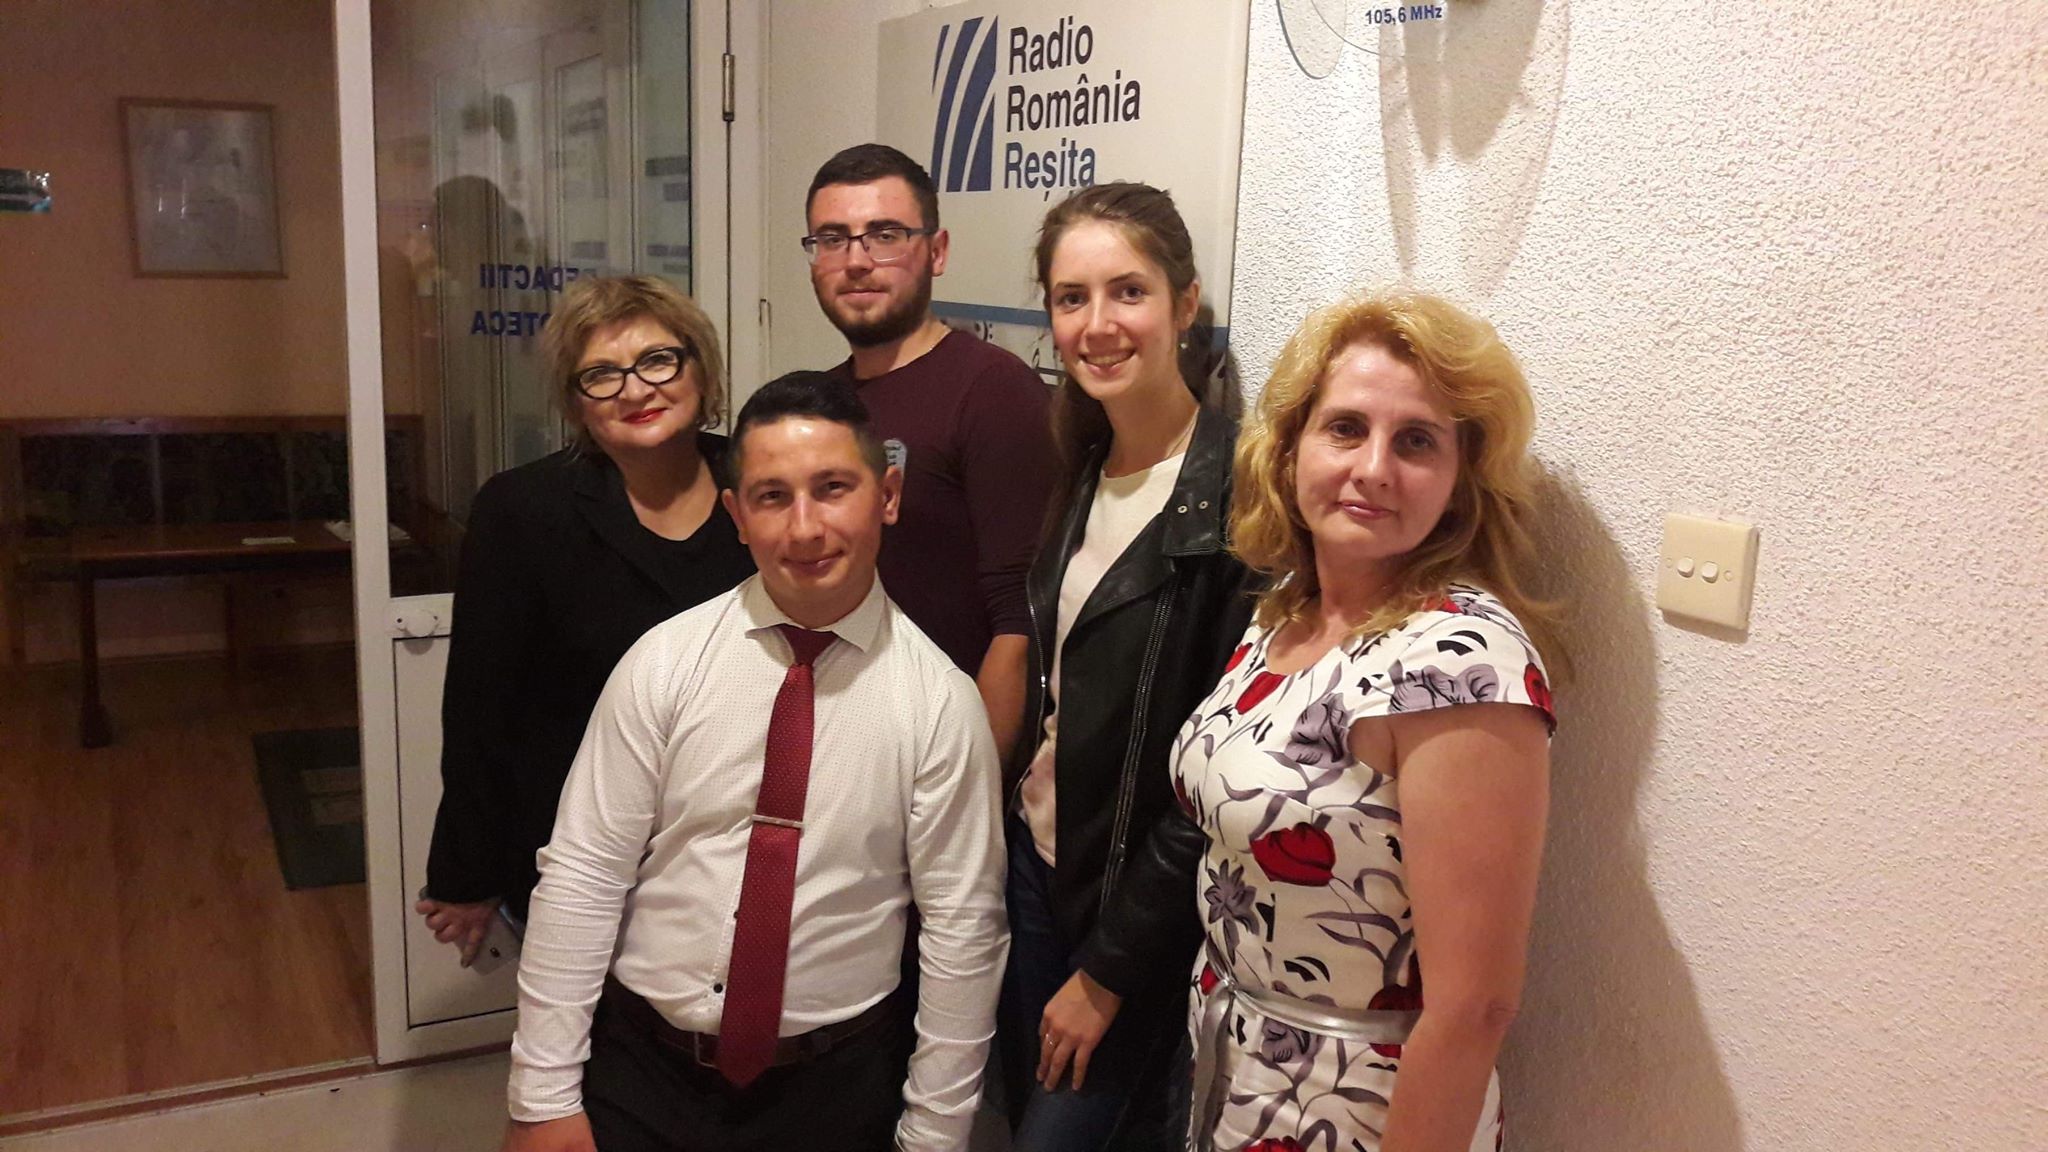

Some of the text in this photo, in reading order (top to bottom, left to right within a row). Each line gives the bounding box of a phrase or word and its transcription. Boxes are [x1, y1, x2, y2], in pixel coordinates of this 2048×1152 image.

[1009, 15, 1093, 75] Radio
[1365, 5, 1443, 25] 105,6 MHz
[1006, 69, 1141, 132] România
